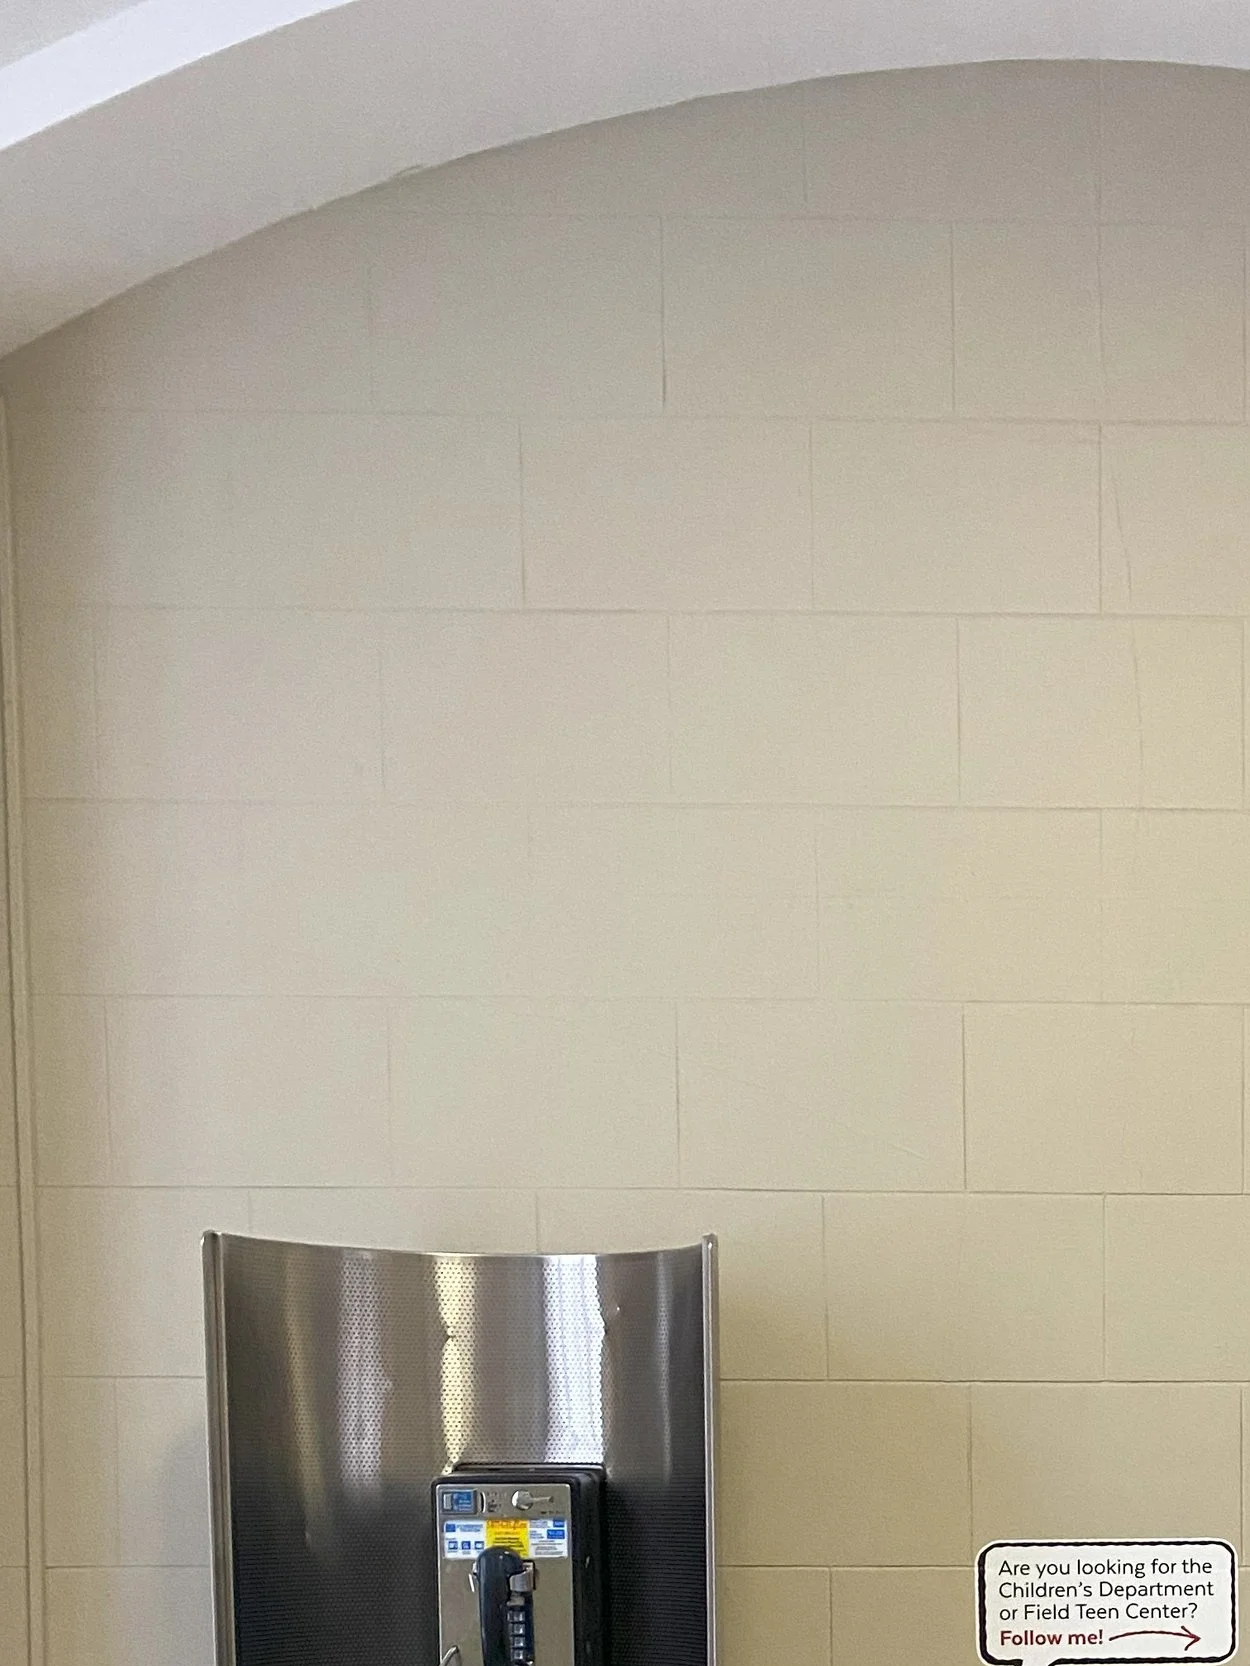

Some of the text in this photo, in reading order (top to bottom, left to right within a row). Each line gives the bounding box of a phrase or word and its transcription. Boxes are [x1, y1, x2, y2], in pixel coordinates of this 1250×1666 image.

[998, 1558, 1213, 1579] Are you looking for the
[998, 1580, 1215, 1601] Children’s Department
[999, 1602, 1199, 1621] or Field Teen Center?
[1000, 1629, 1104, 1646] Follow me!
